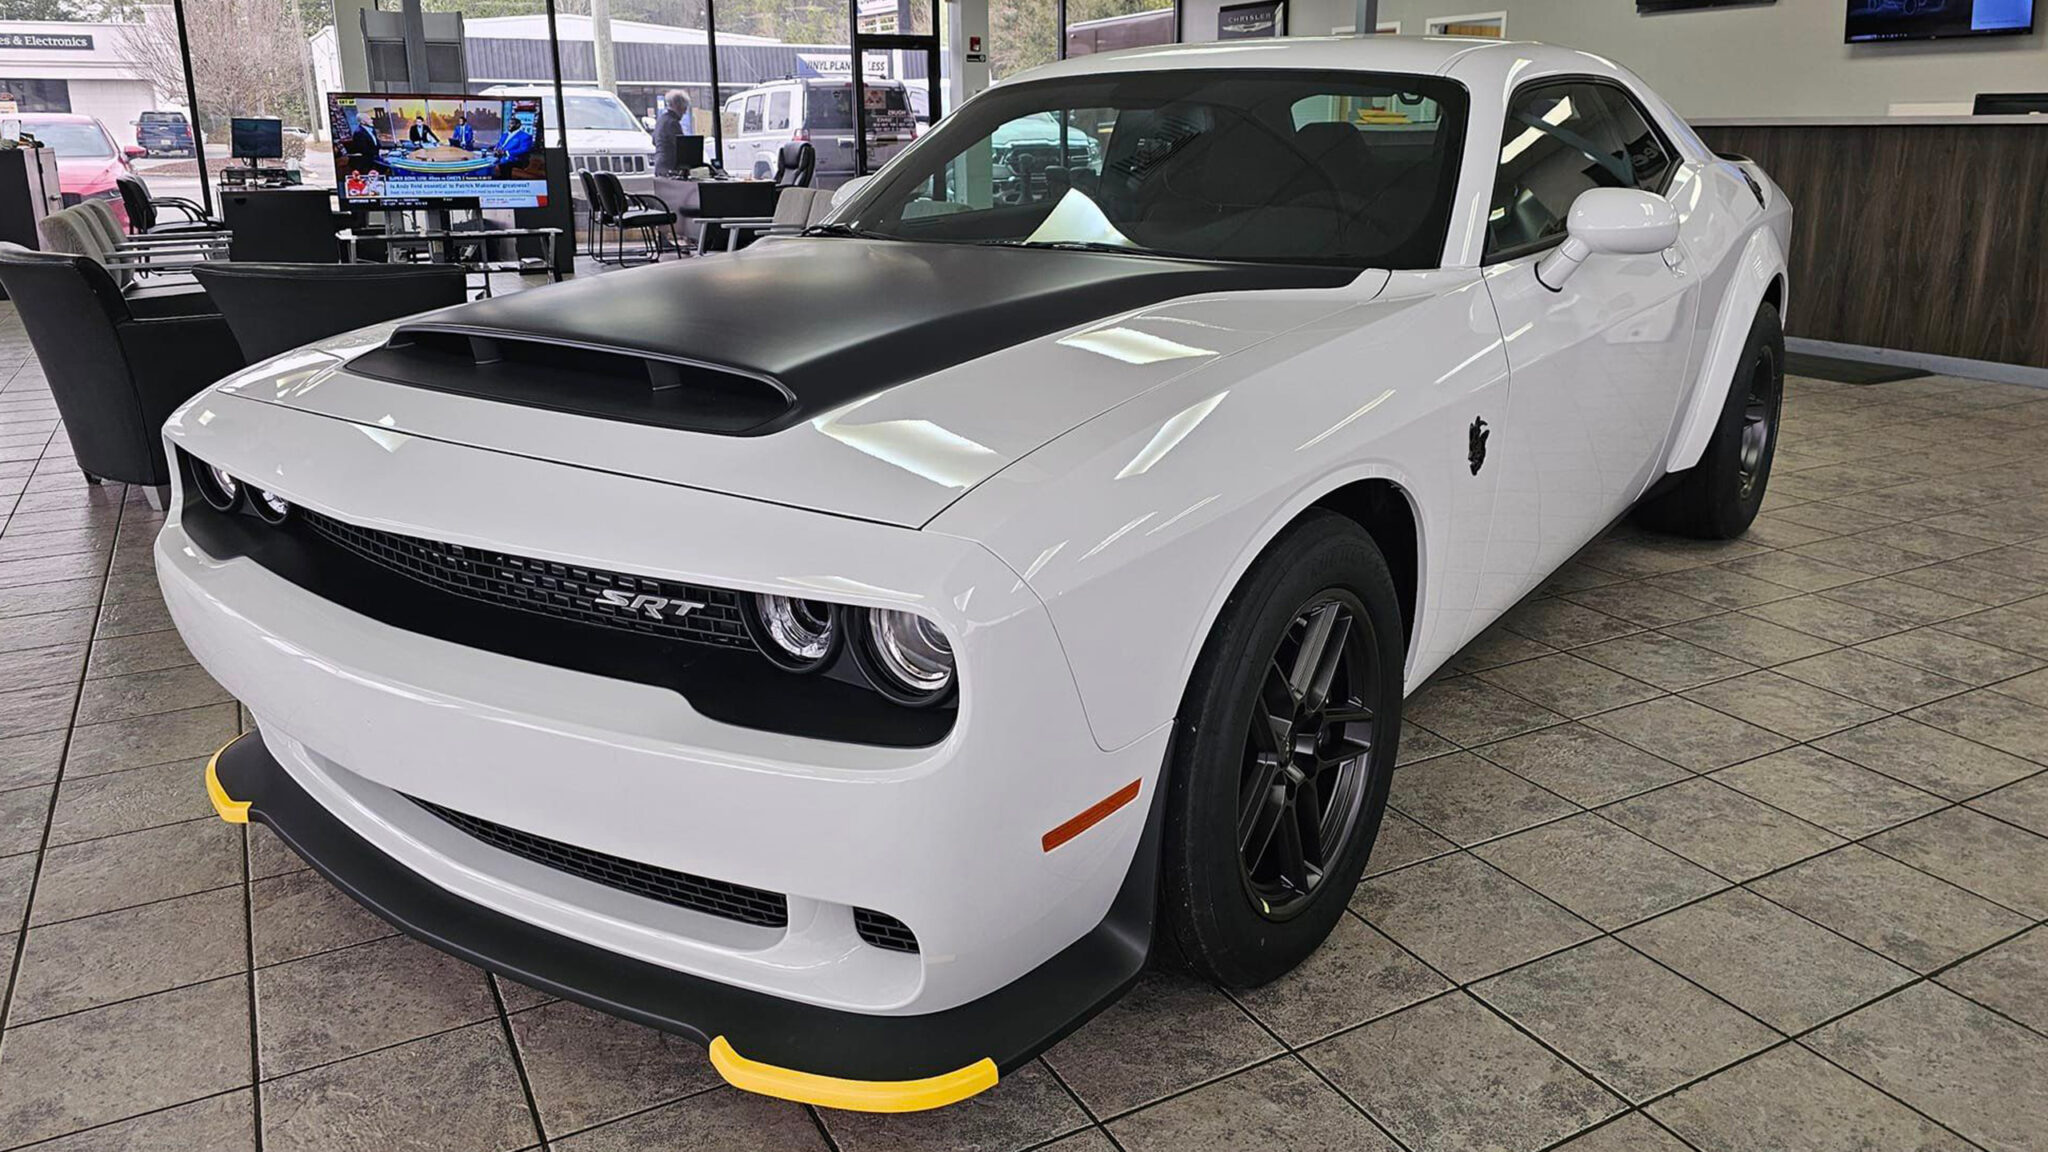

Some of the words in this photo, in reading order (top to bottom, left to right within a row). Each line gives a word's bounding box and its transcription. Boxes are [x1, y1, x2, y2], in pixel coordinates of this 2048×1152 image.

[12, 36, 23, 46] &
[24, 36, 88, 47] Electronics
[594, 589, 706, 620] SRT
